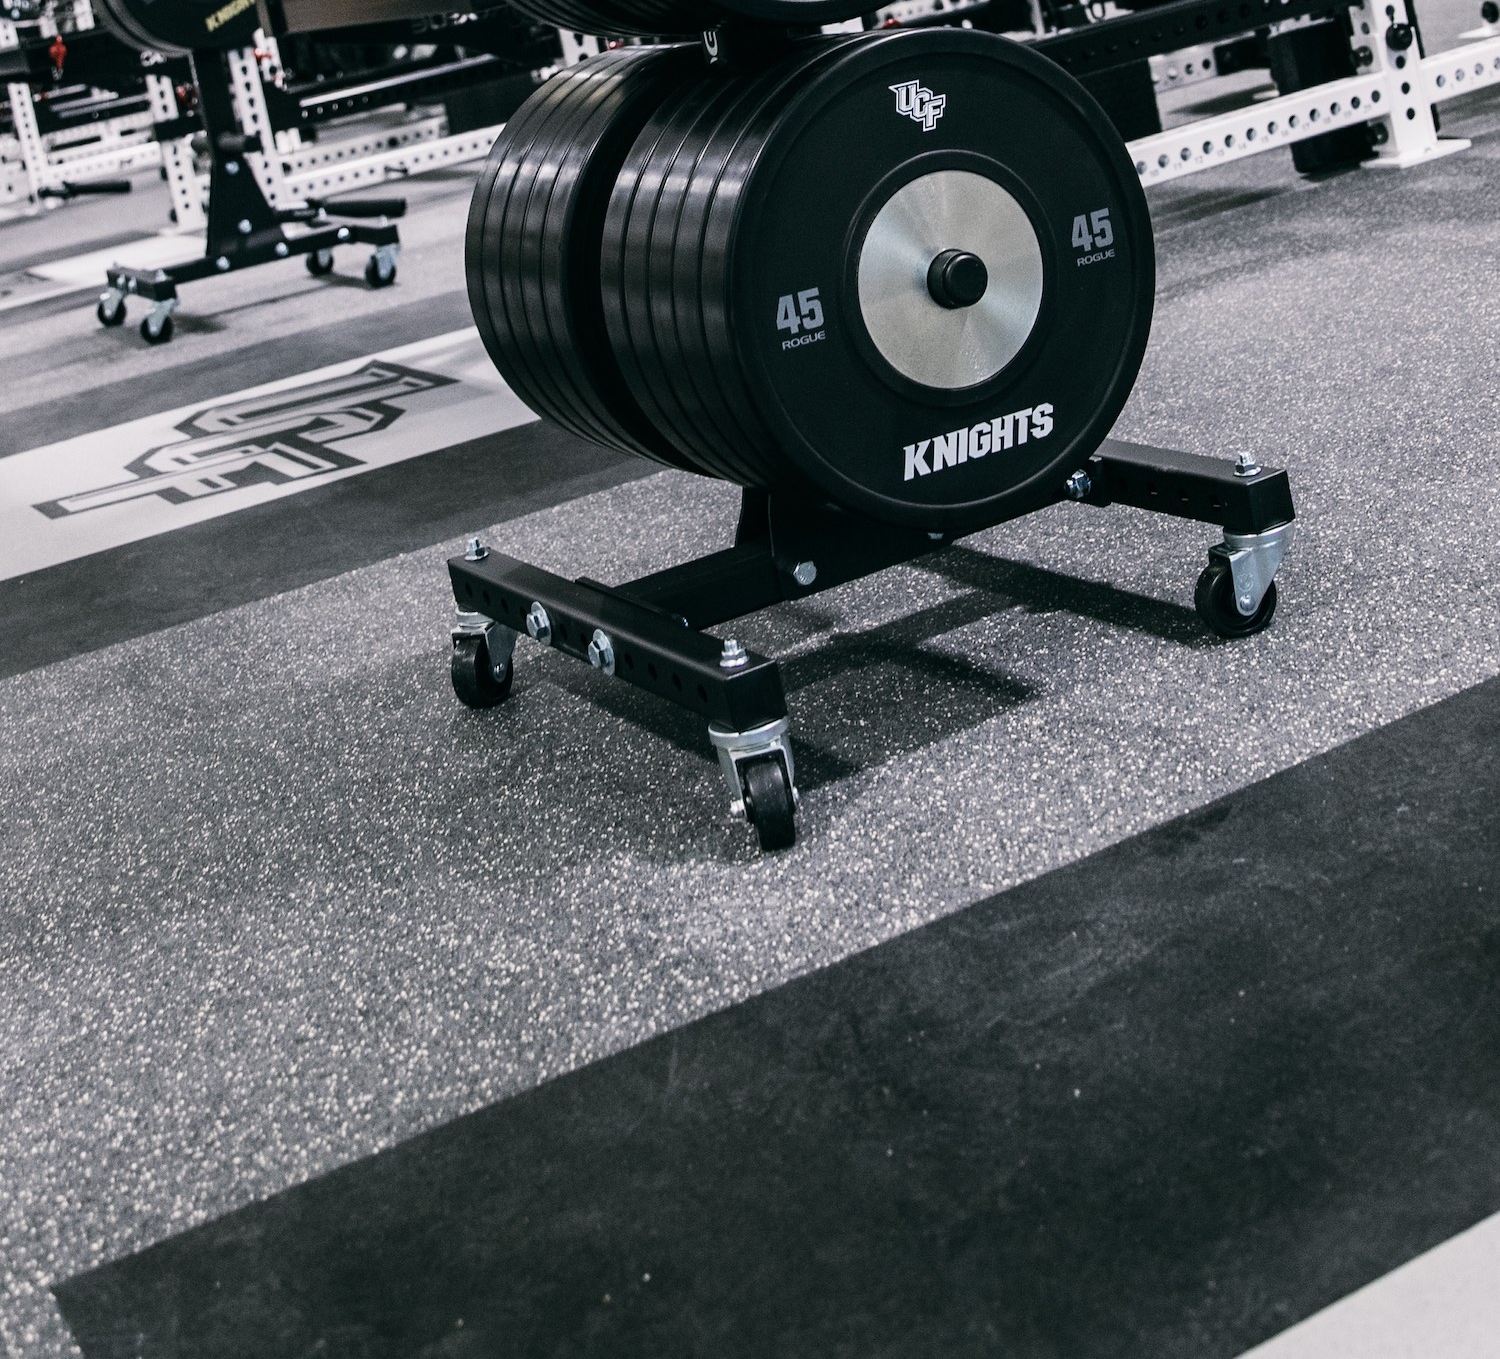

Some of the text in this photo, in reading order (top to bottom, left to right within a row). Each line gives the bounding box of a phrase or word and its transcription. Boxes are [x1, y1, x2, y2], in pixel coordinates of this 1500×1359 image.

[888, 79, 946, 132] UCF
[1071, 207, 1114, 252] 45
[1077, 248, 1116, 267] ROGUE
[776, 286, 824, 334] 45
[781, 330, 827, 351] ROGUE
[902, 402, 1054, 482] KNIGHTS
